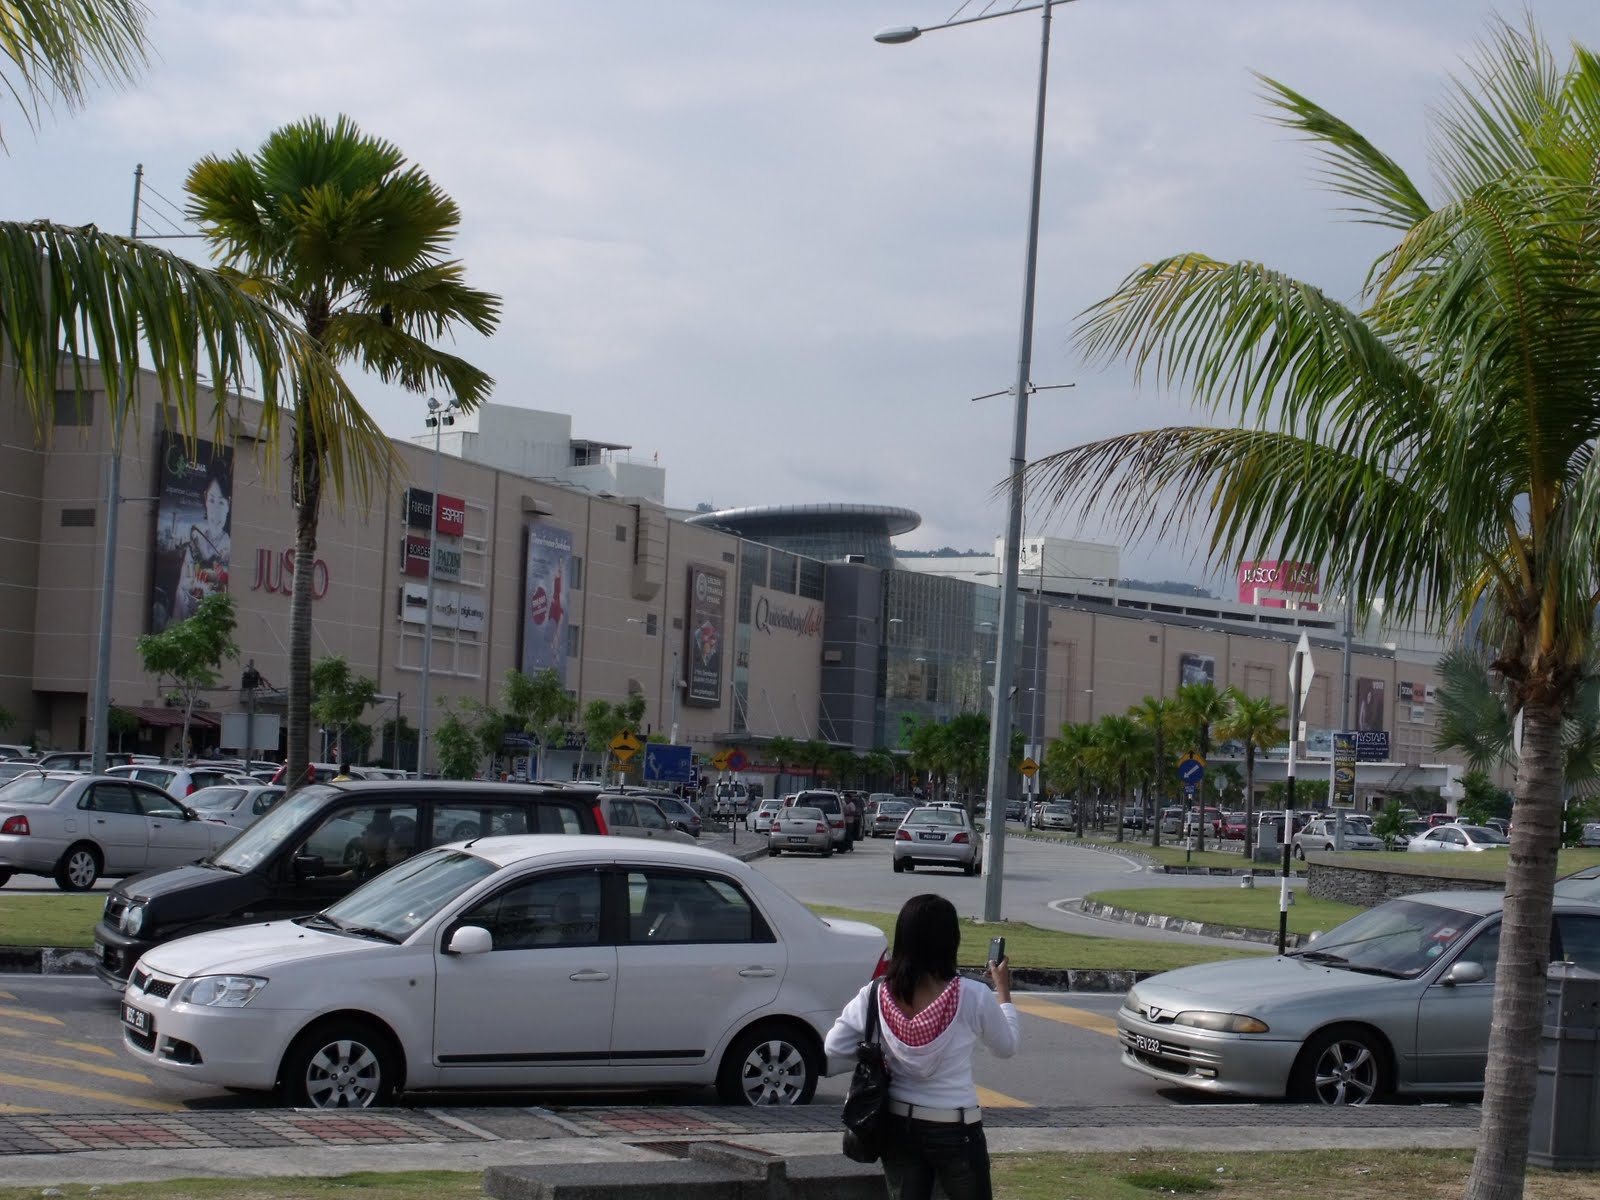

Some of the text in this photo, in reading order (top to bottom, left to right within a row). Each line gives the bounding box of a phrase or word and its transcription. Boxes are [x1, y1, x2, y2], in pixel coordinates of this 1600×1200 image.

[411, 501, 431, 516] FOREVER
[441, 507, 465, 524] ESPRIT
[409, 543, 431, 557] BORDER
[248, 548, 329, 600] JUSO
[1243, 567, 1278, 583] JUSCO
[1359, 732, 1387, 744] AYSTAR
